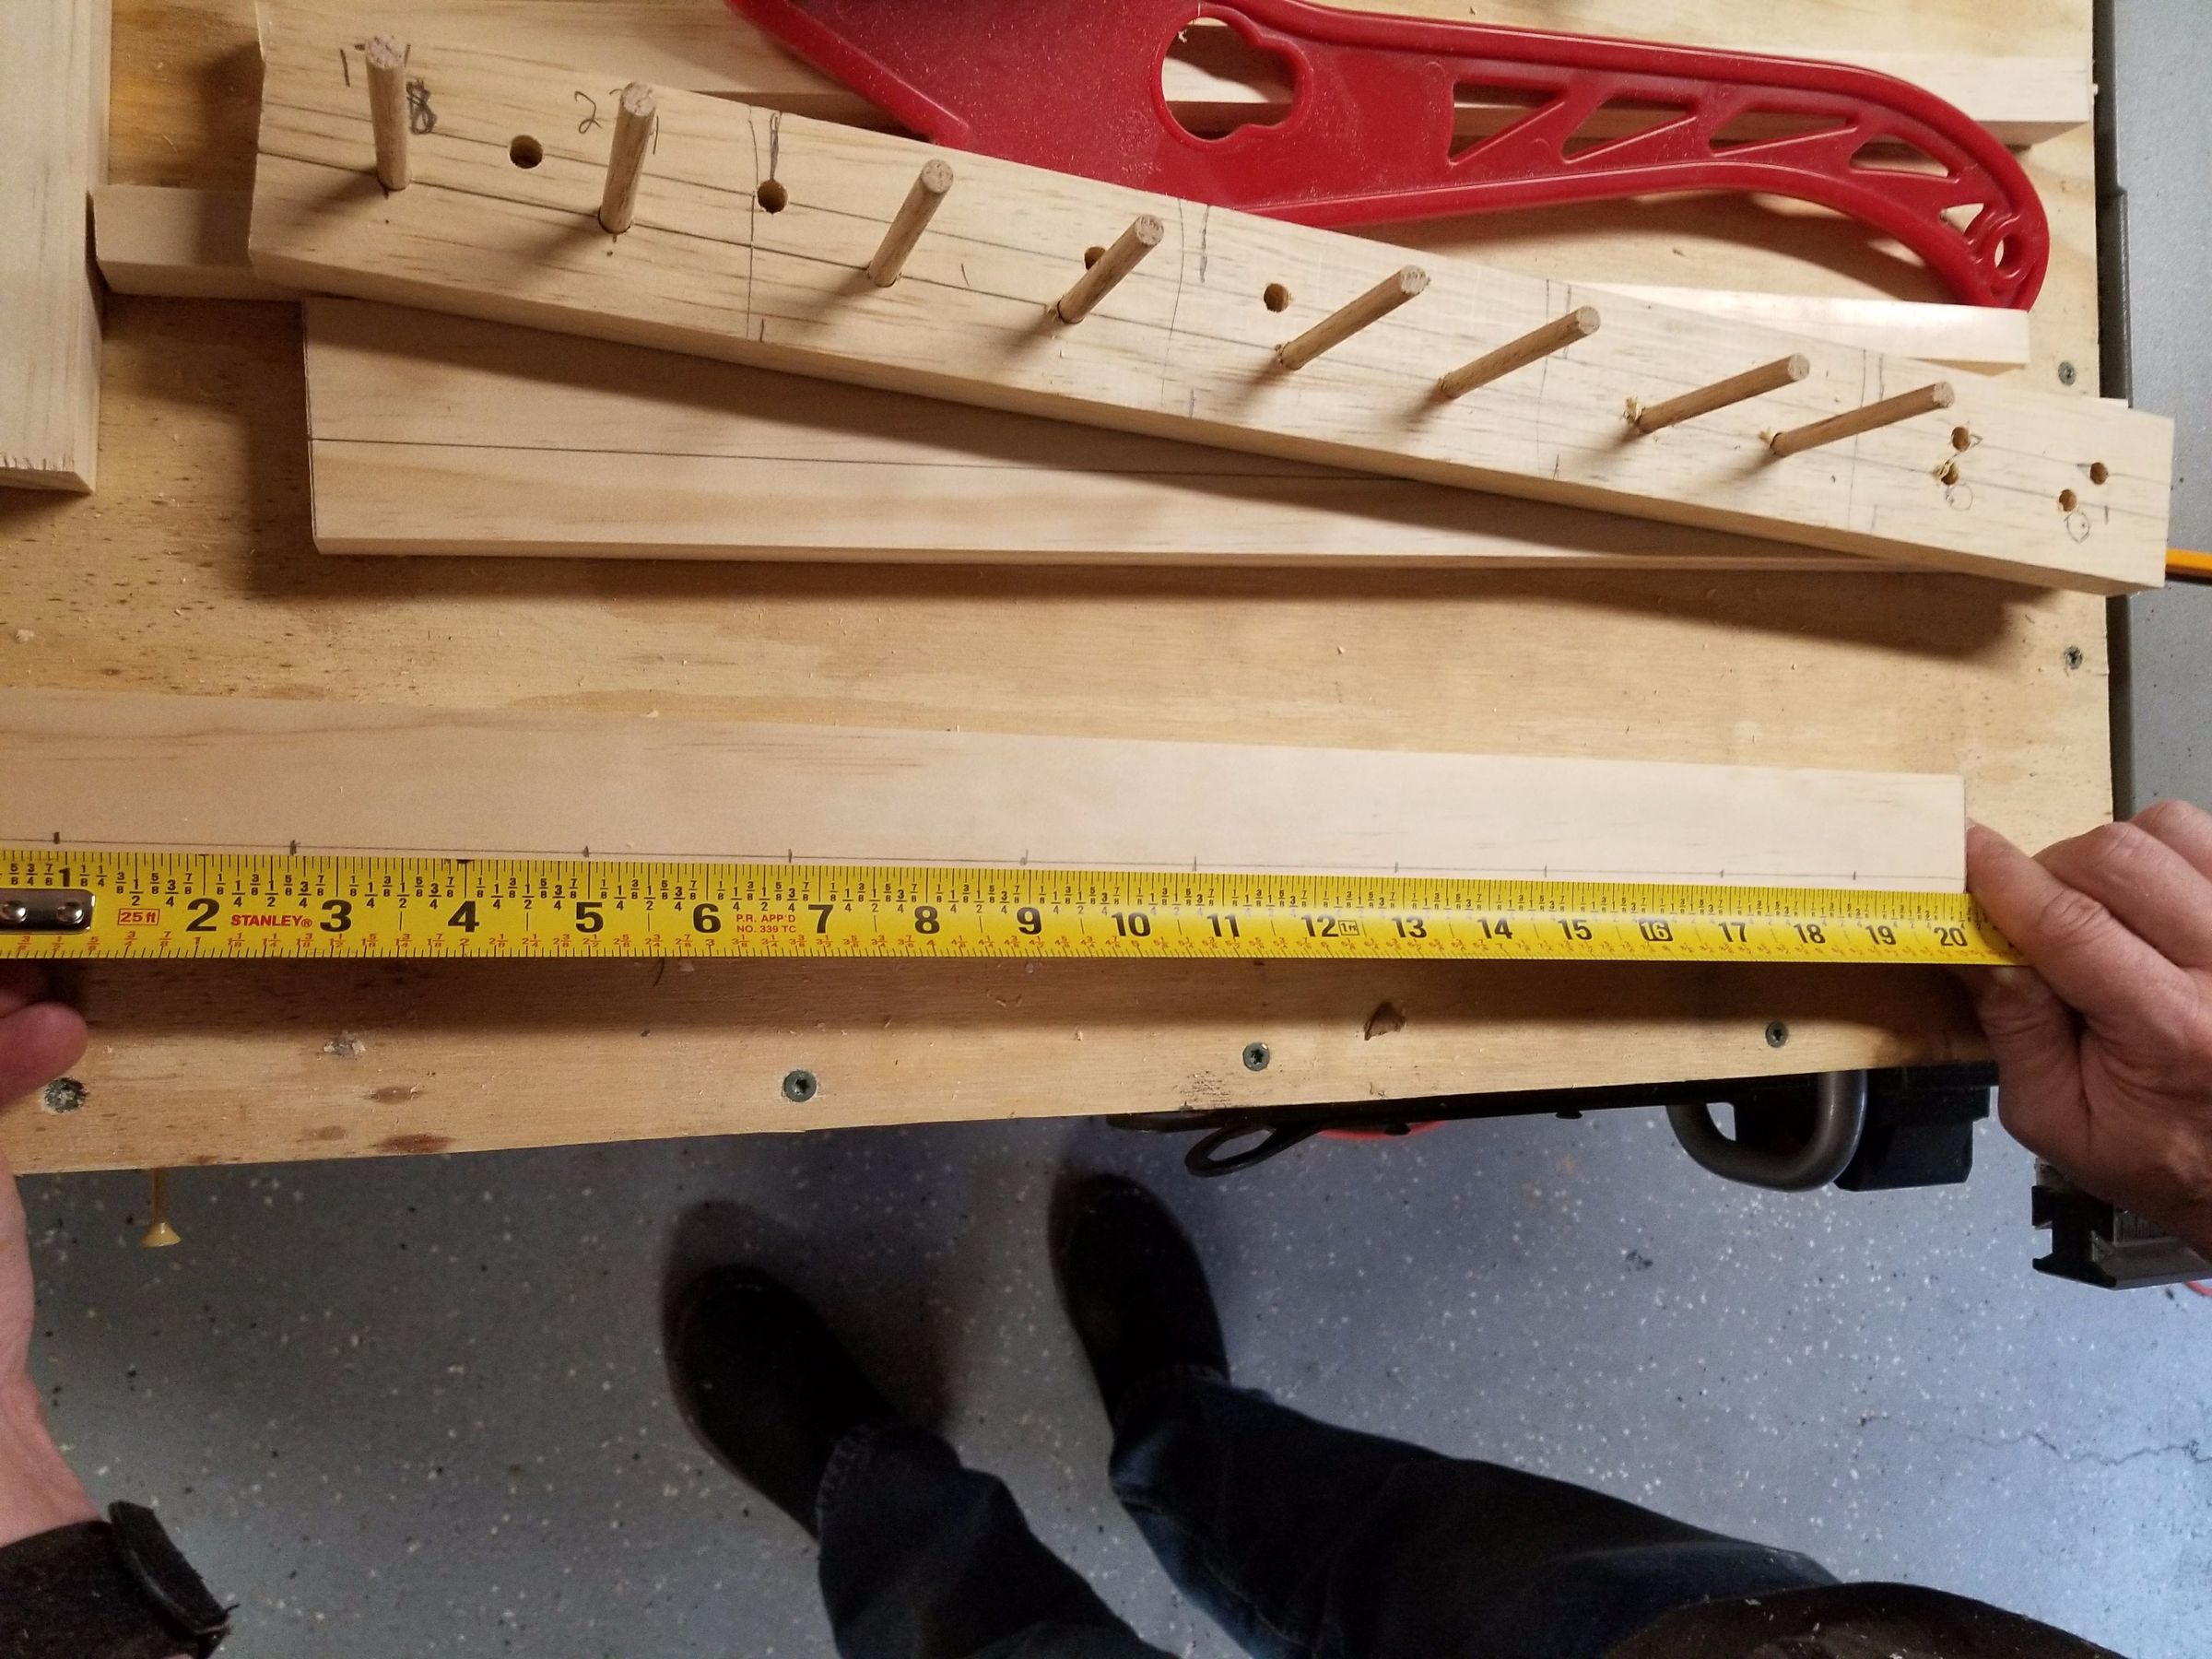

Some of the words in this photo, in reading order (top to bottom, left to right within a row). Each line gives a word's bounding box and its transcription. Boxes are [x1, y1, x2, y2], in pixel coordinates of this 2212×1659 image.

[186, 898, 219, 931] 2
[320, 900, 352, 932] 3
[448, 900, 479, 933] 4
[575, 901, 604, 933] 5
[693, 903, 721, 933] 6
[807, 904, 834, 934] 7
[914, 905, 940, 935] 8
[1016, 907, 1041, 935] 9
[1111, 912, 1151, 936] 10
[1206, 912, 1240, 937] 11
[1301, 914, 1338, 936] 12
[1392, 916, 1427, 938] 13
[1477, 917, 1512, 939] 14
[1559, 919, 1593, 940] 15
[1639, 919, 1673, 942] 16
[1718, 922, 1747, 942] 17
[1794, 923, 1826, 944] 18
[1865, 924, 1897, 945] 19
[1934, 927, 1968, 946] 20
